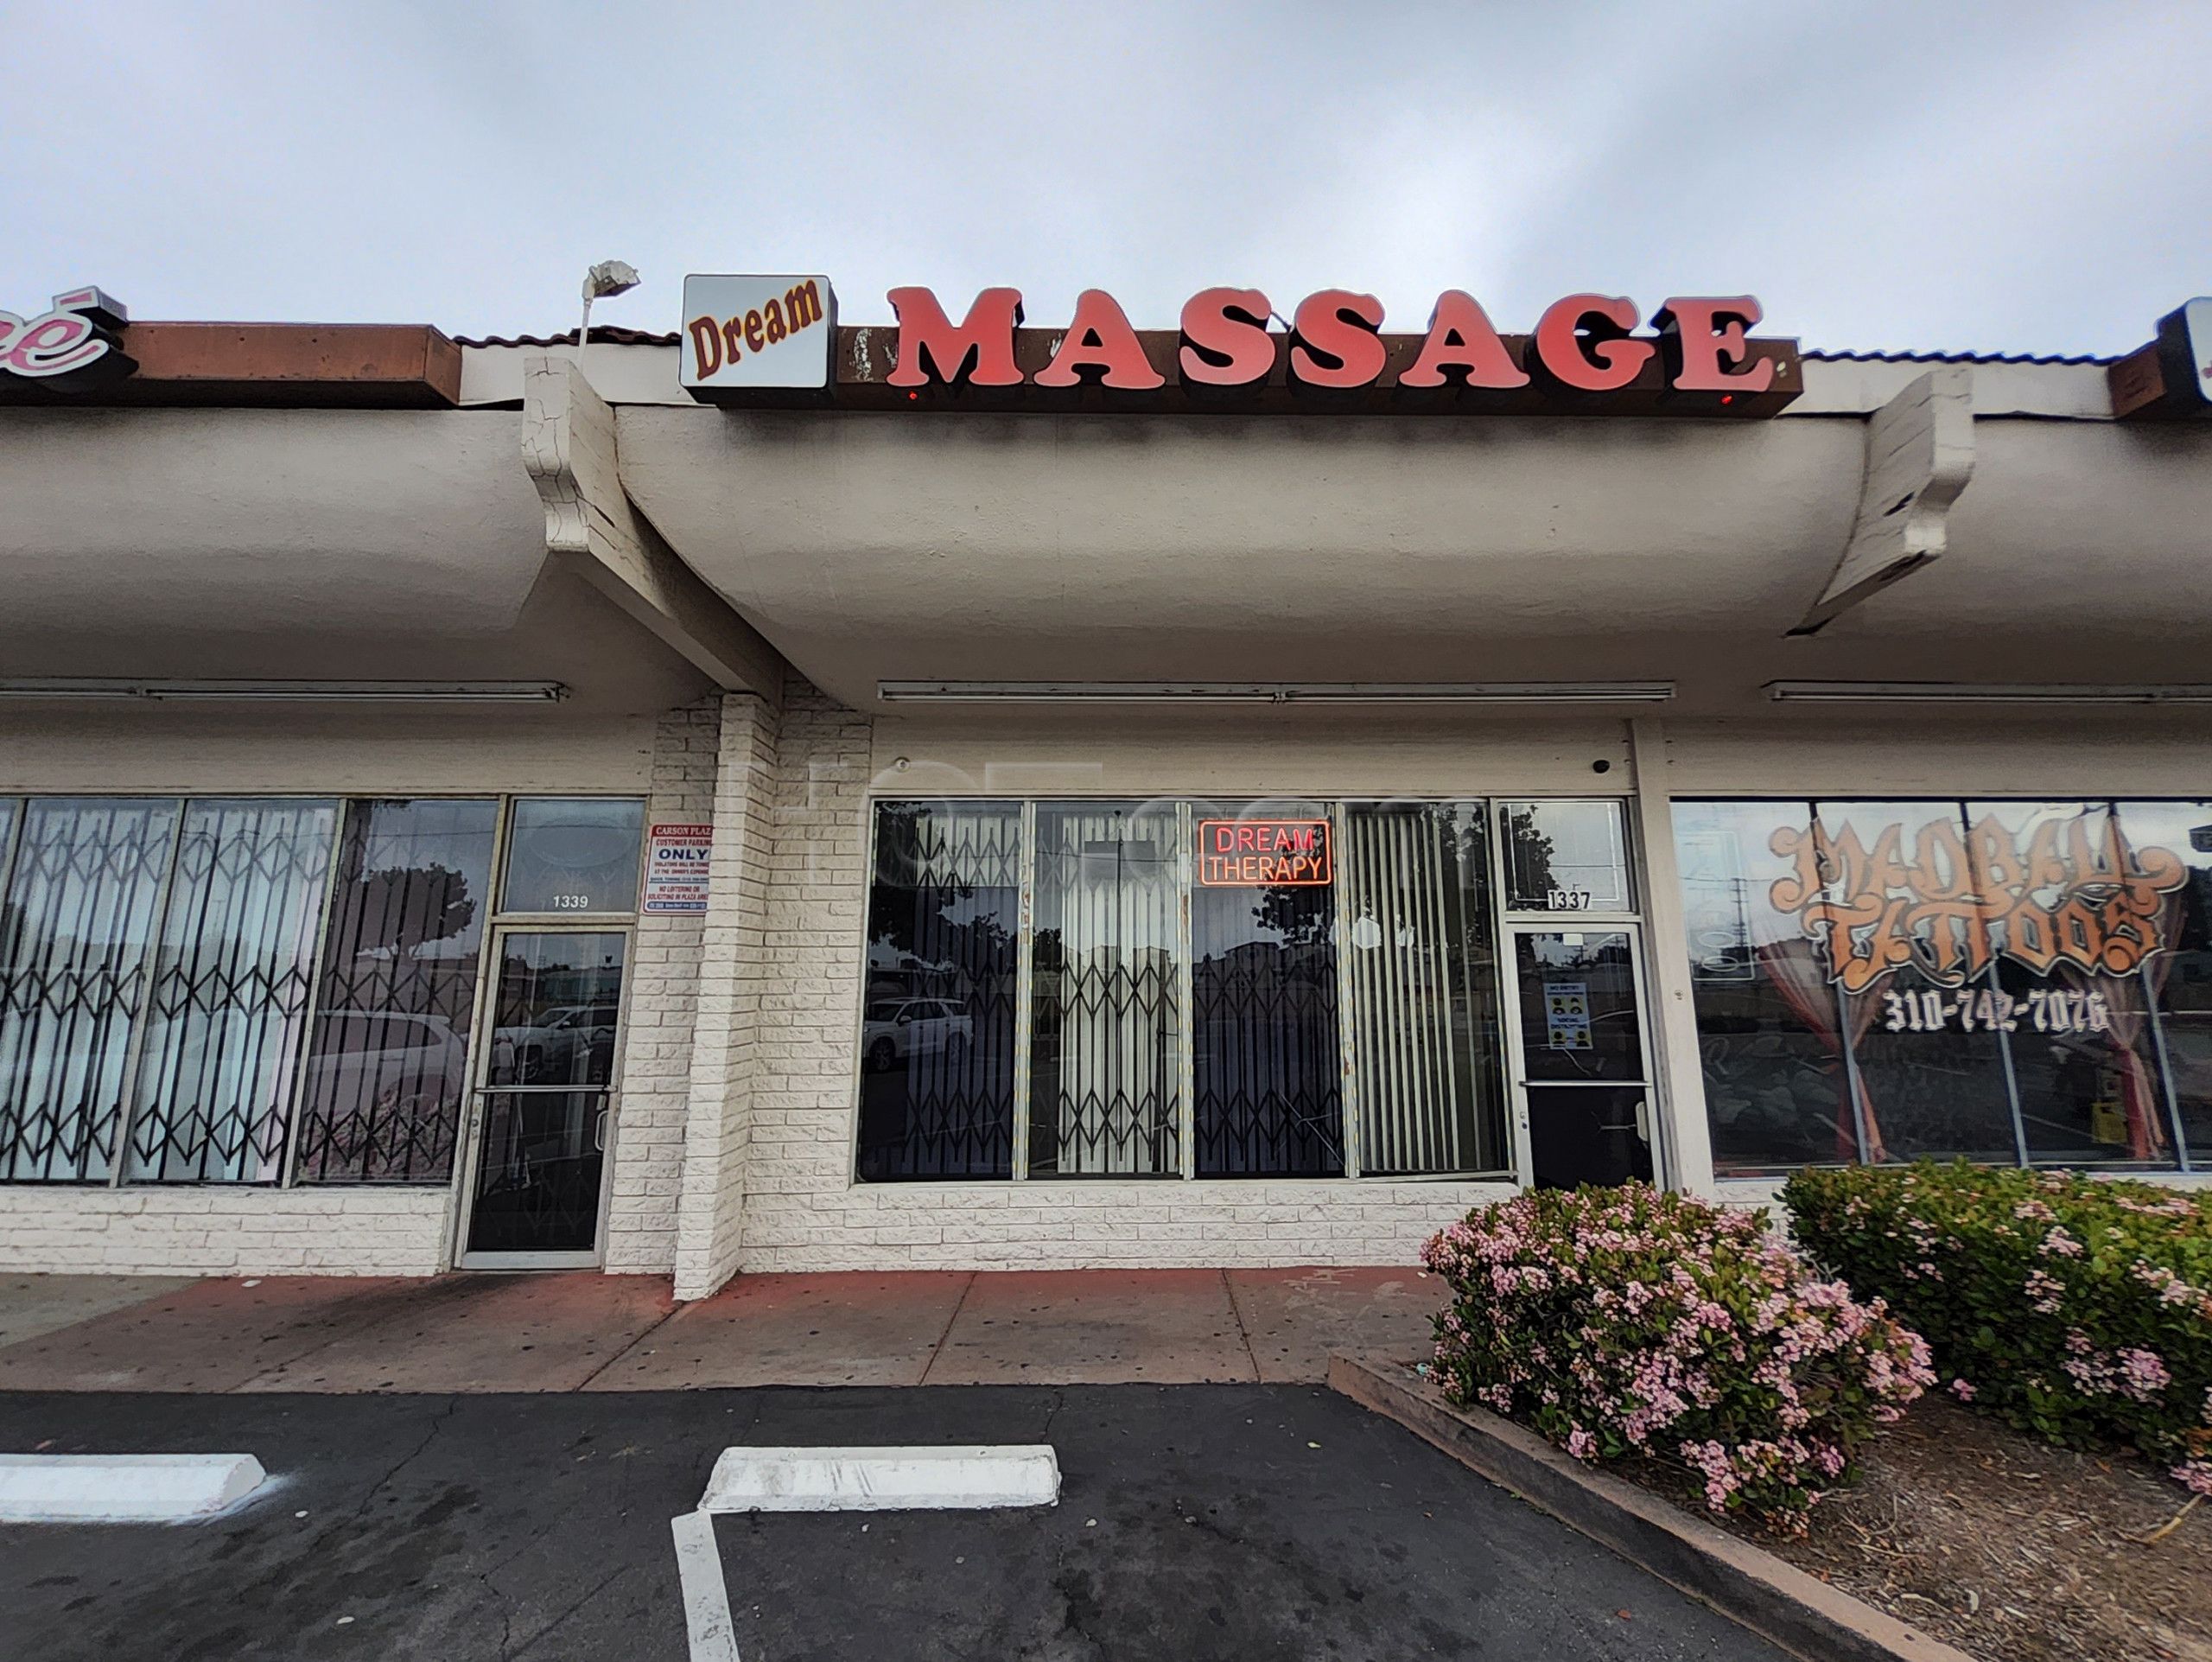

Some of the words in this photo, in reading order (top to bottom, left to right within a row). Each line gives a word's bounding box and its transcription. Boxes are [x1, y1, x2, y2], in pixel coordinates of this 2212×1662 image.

[689, 278, 823, 381] Dream
[887, 286, 1774, 392] MASSAGE
[656, 826, 689, 836] CARSON
[690, 826, 712, 836] PLAZ
[1216, 826, 1314, 852] DREAM
[658, 849, 709, 860] ONLY
[1208, 856, 1323, 881] THERAPY
[553, 895, 588, 908] 1339
[1549, 891, 1591, 909] 1337
[1801, 888, 2165, 993] TATTOOS
[1882, 989, 2109, 1033] 310-742-7076
